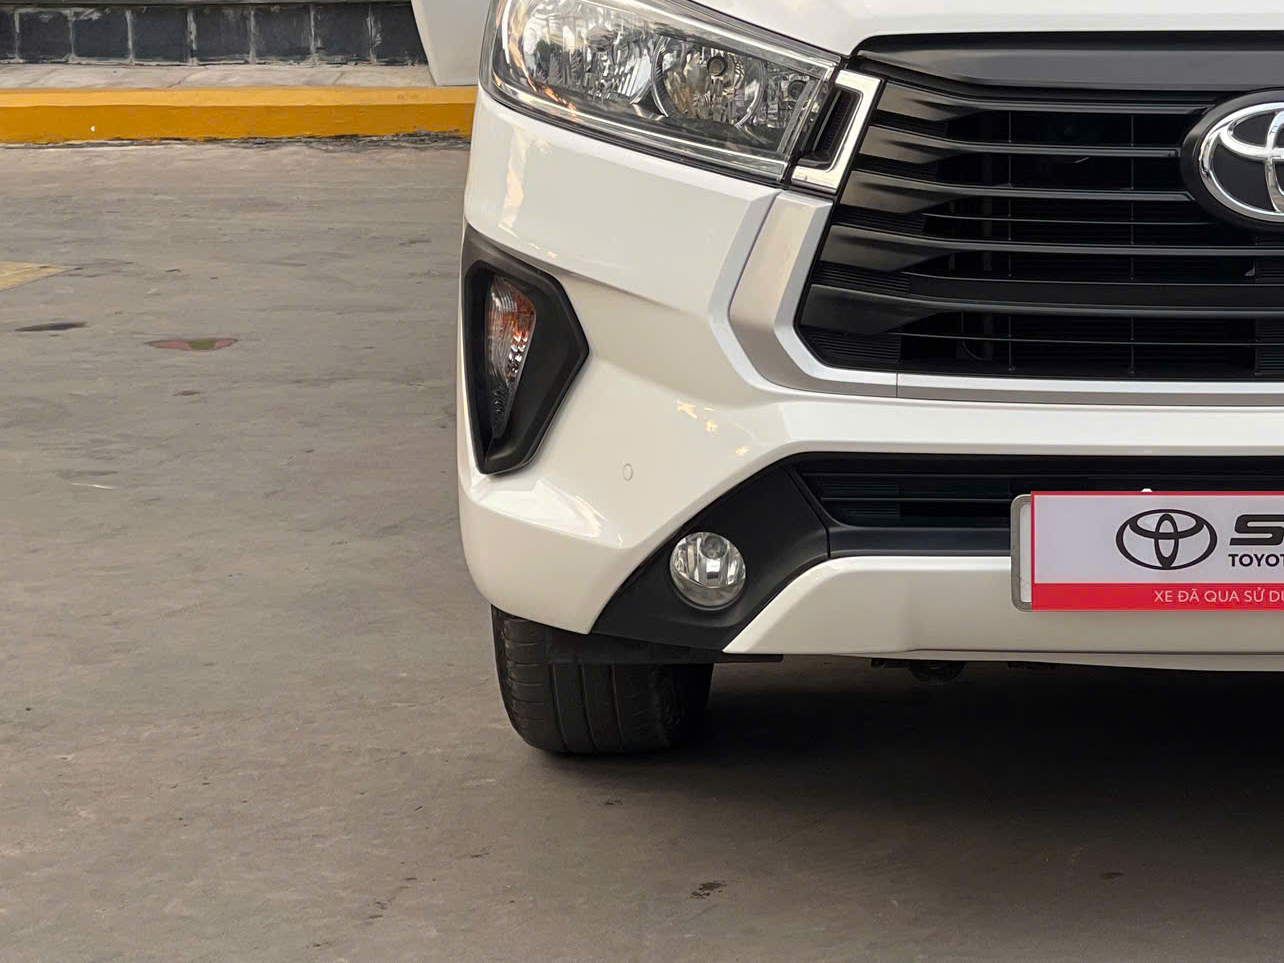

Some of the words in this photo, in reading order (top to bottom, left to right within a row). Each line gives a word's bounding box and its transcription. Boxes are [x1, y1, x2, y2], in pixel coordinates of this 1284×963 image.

[1154, 590, 1173, 603] XE
[1177, 587, 1200, 603] ĐÃ
[1203, 590, 1239, 604] QUA
[1243, 586, 1265, 603] SỬ
